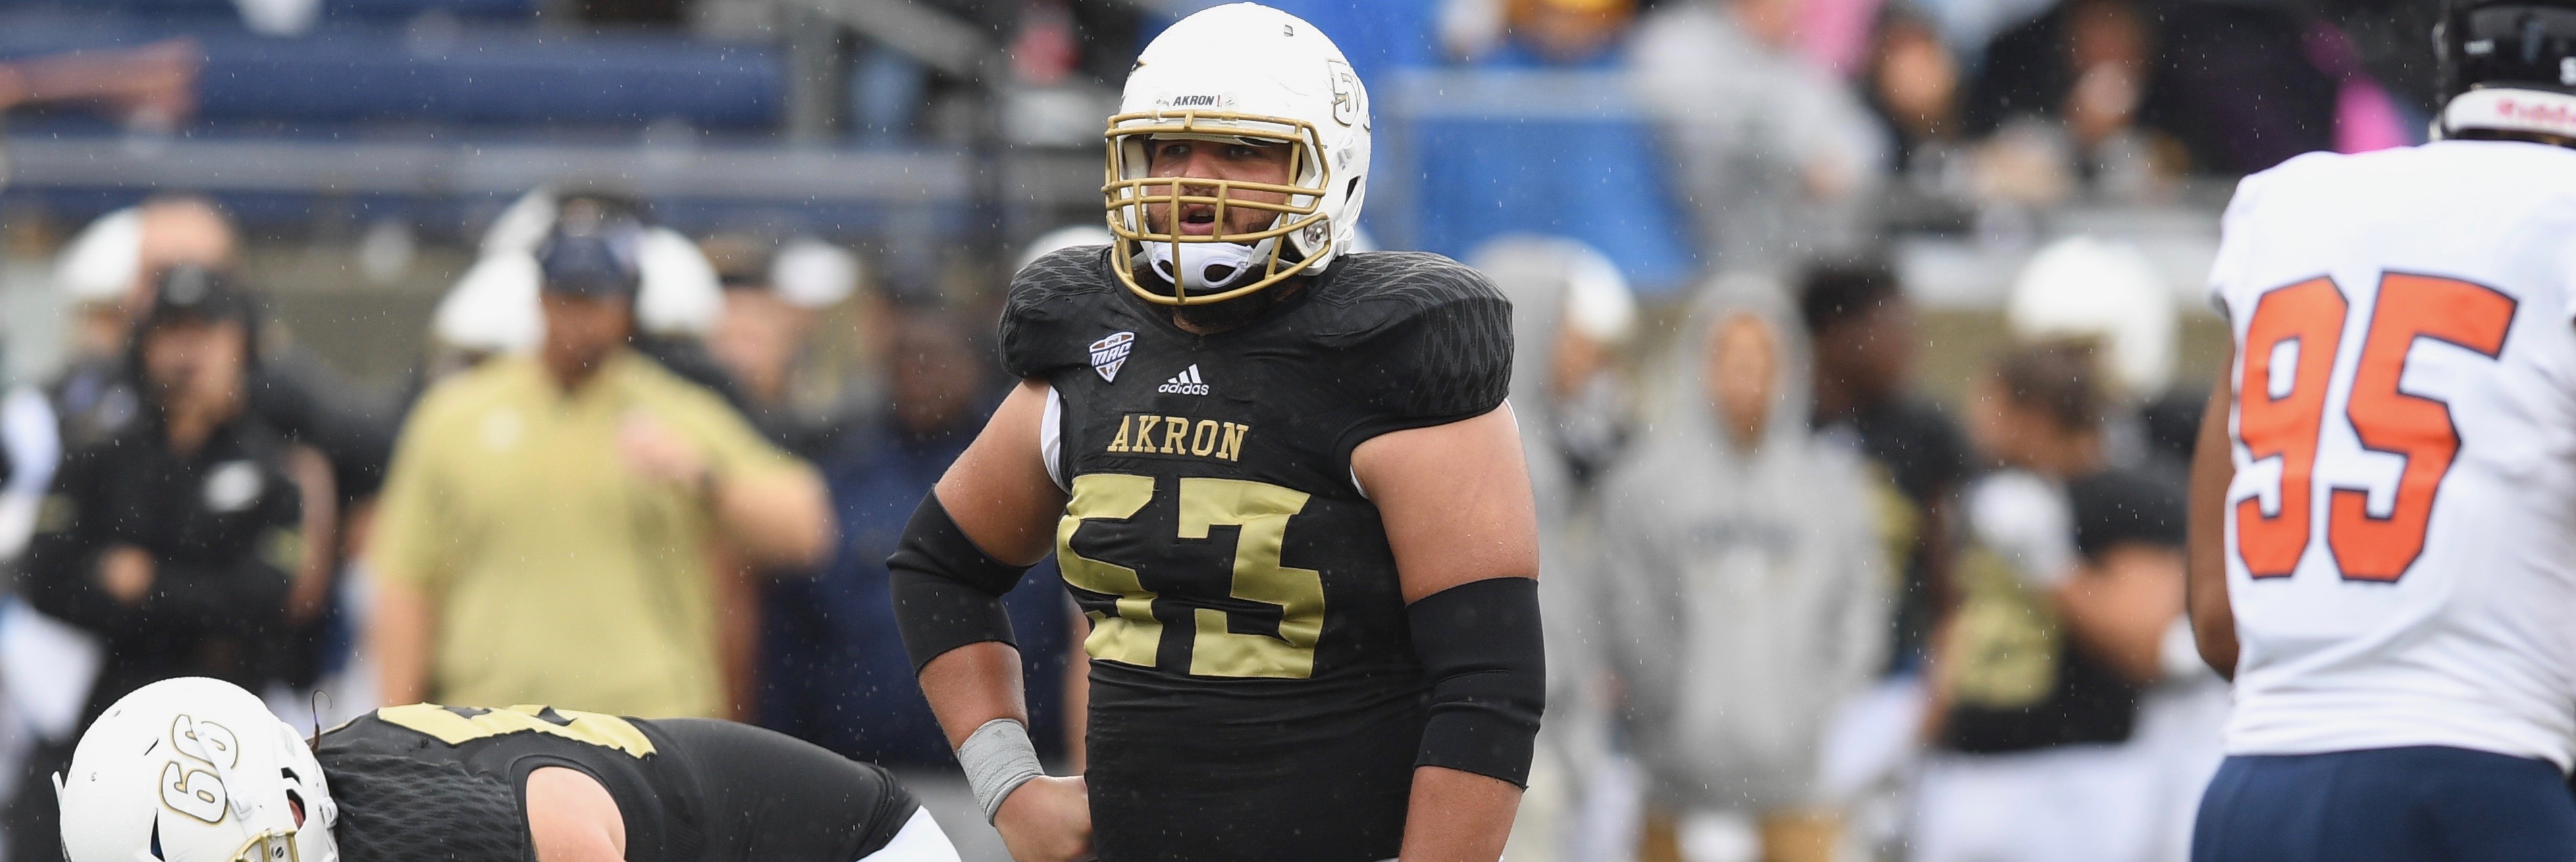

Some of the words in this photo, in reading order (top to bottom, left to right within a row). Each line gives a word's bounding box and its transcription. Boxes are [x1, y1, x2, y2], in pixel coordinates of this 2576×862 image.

[1173, 95, 1215, 107] AKRON
[1091, 342, 1132, 367] MAC
[1158, 382, 1209, 396] adidas
[1107, 414, 1249, 462] AKRON
[2234, 270, 2519, 583] 95
[1056, 474, 1325, 679] 53
